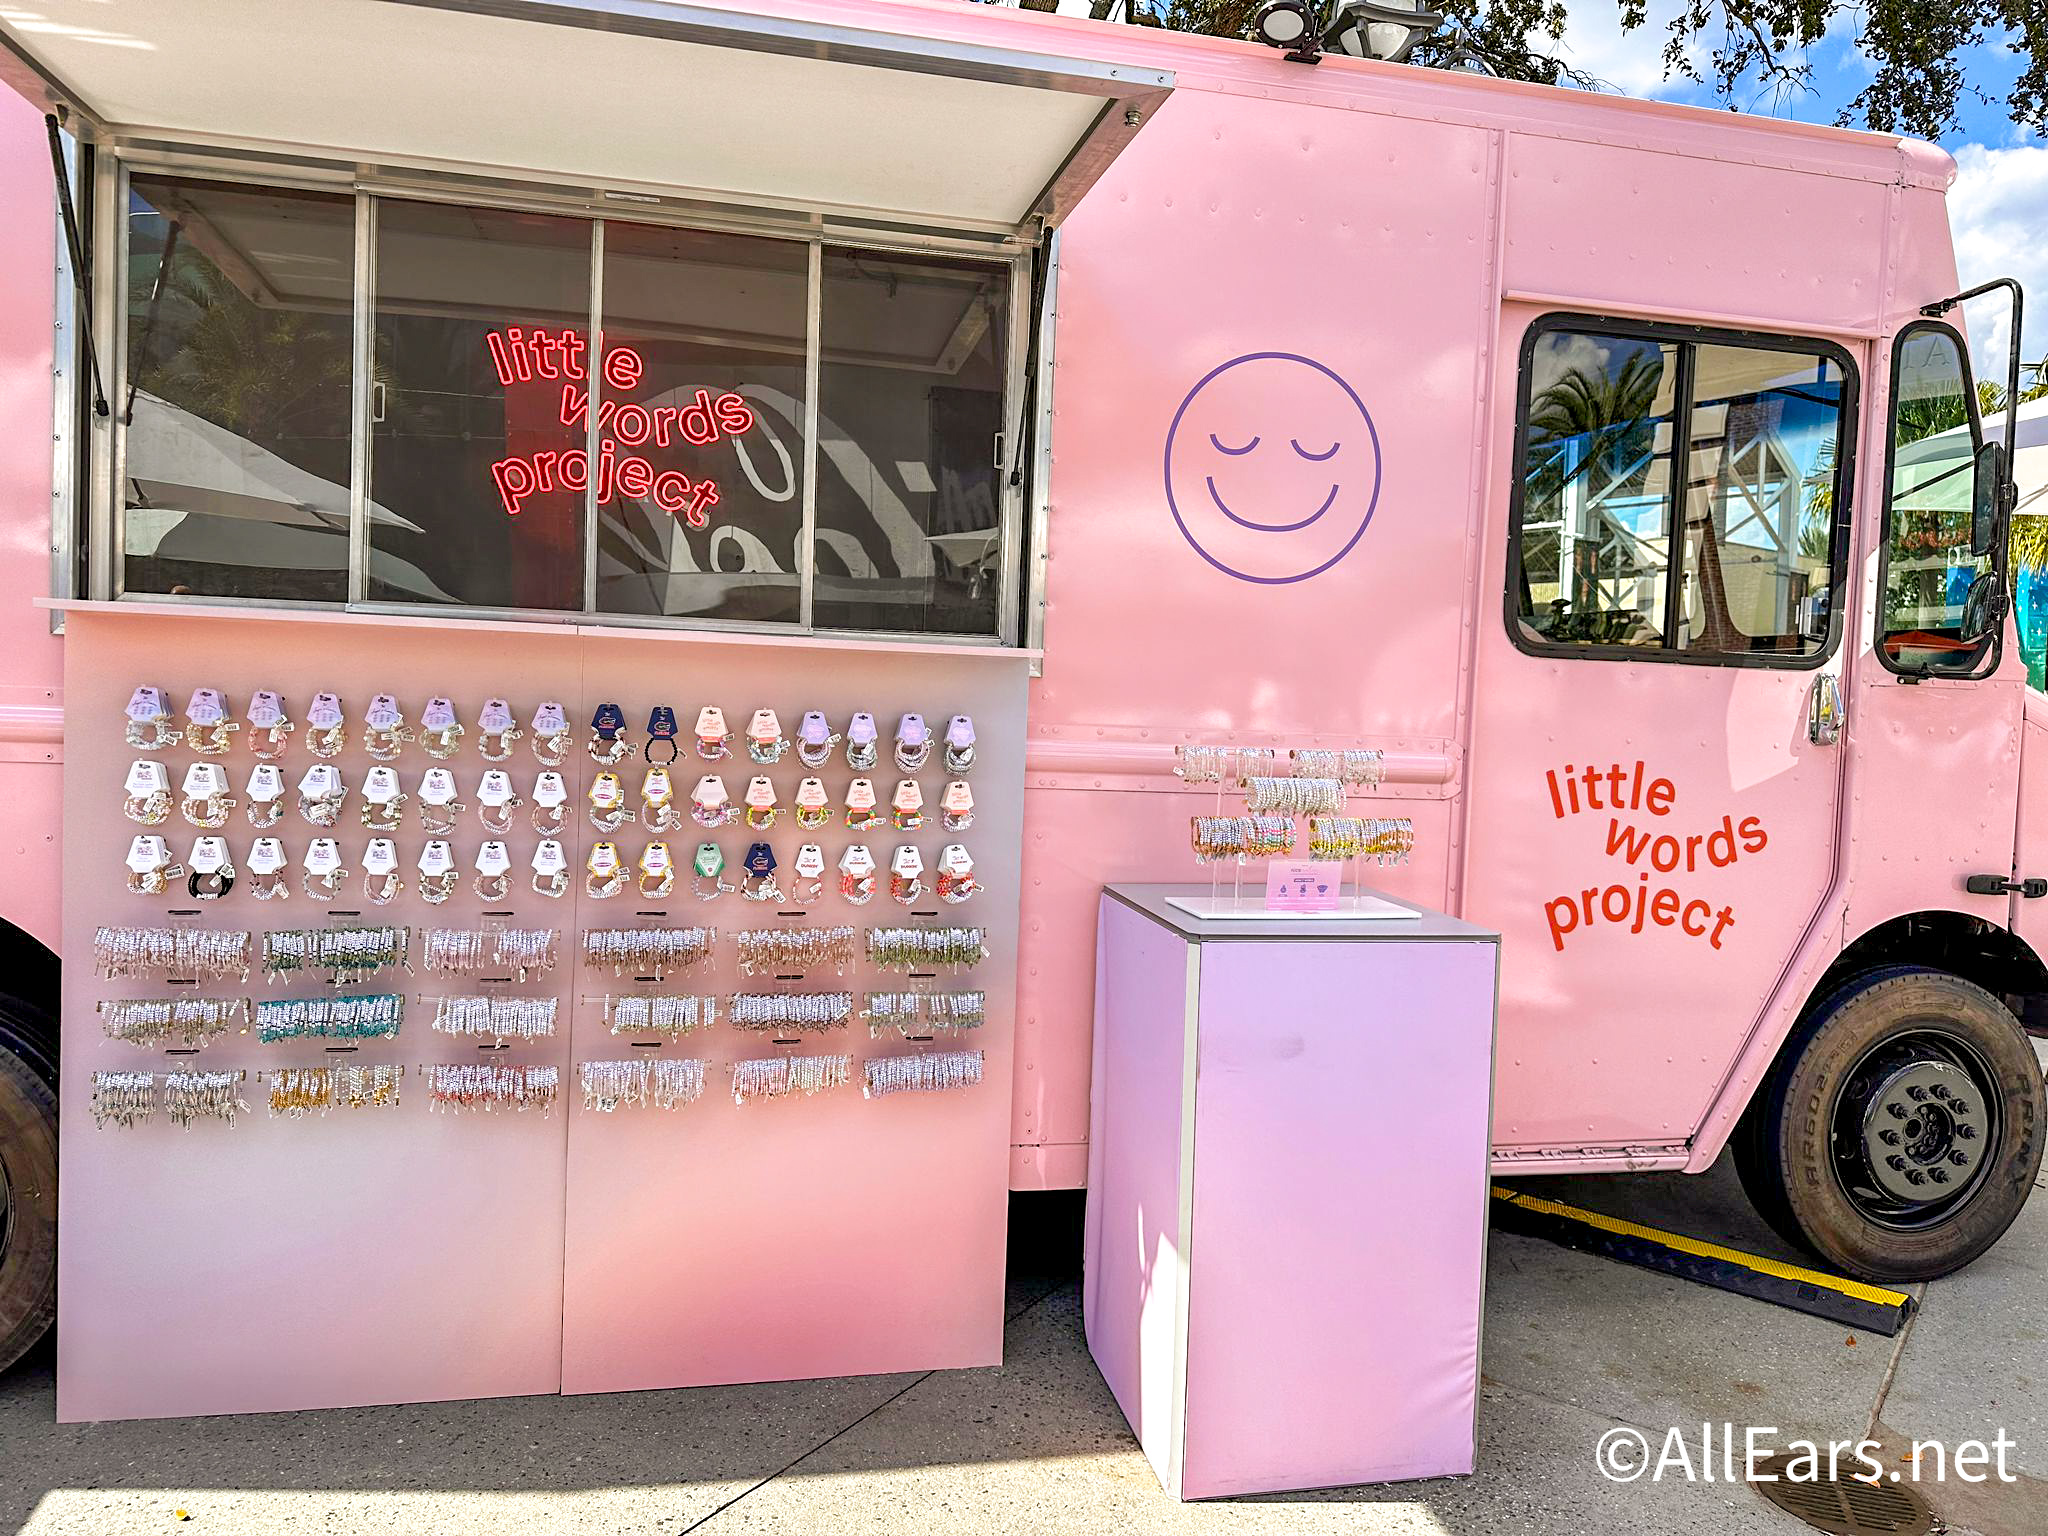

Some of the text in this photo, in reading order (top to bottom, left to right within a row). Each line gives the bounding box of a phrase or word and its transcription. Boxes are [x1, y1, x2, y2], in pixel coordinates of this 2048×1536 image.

[487, 328, 643, 390] litte
[560, 384, 754, 447] words
[491, 439, 720, 527] project
[1546, 761, 1675, 818] little
[1606, 815, 1768, 872] words
[1544, 872, 1735, 952] project
